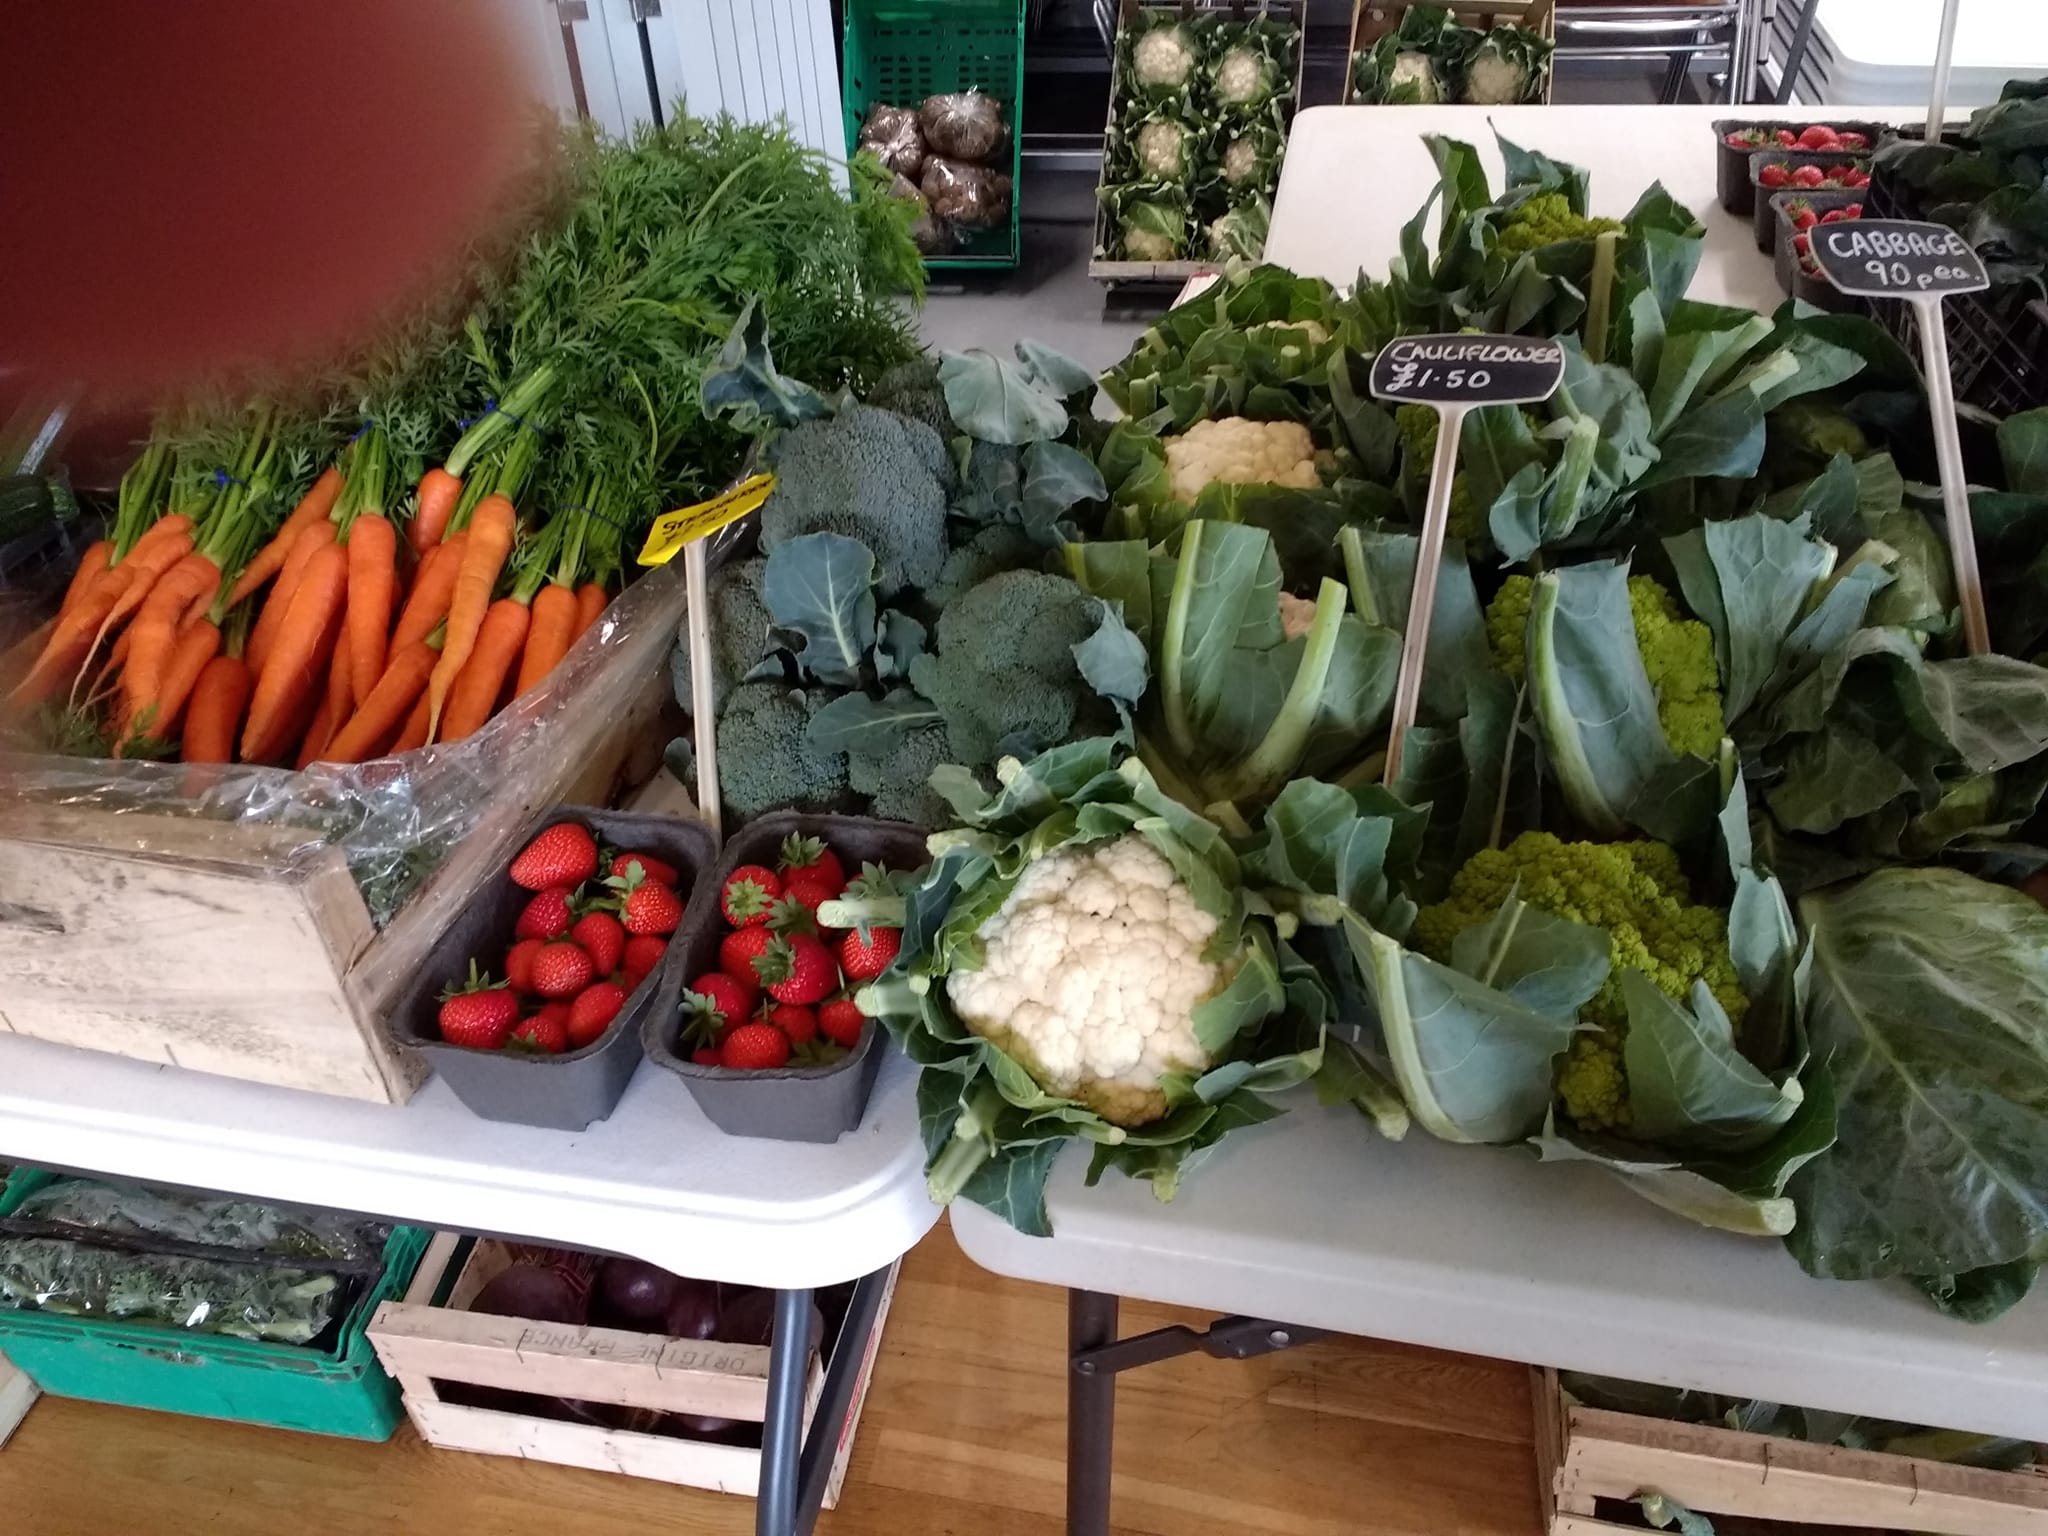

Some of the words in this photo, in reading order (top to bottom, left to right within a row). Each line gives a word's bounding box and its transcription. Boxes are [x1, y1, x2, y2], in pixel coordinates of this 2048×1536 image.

[1827, 230, 1967, 258] CABBAGE
[1390, 341, 1561, 363] CAULIFLOWER
[1385, 362, 1491, 392] £1.50
